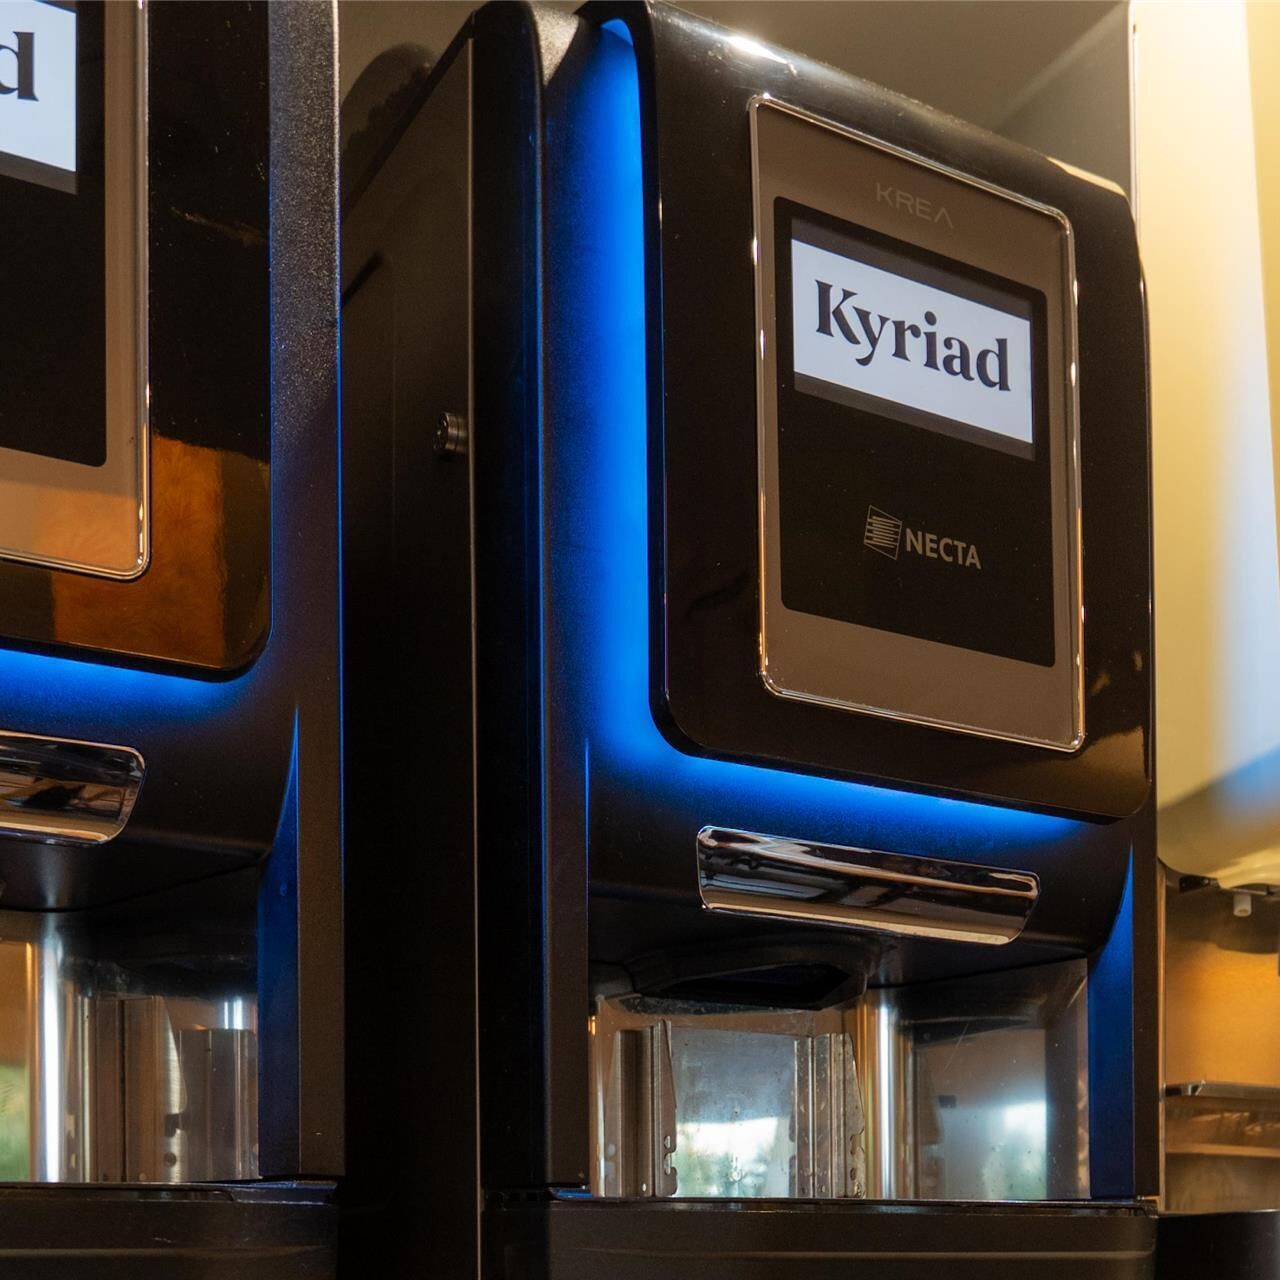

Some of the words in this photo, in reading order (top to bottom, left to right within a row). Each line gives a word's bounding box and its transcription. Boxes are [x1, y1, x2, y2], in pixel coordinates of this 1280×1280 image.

[876, 183, 955, 229] KREA
[814, 279, 1011, 392] Kyriad
[905, 529, 982, 569] NECTA
